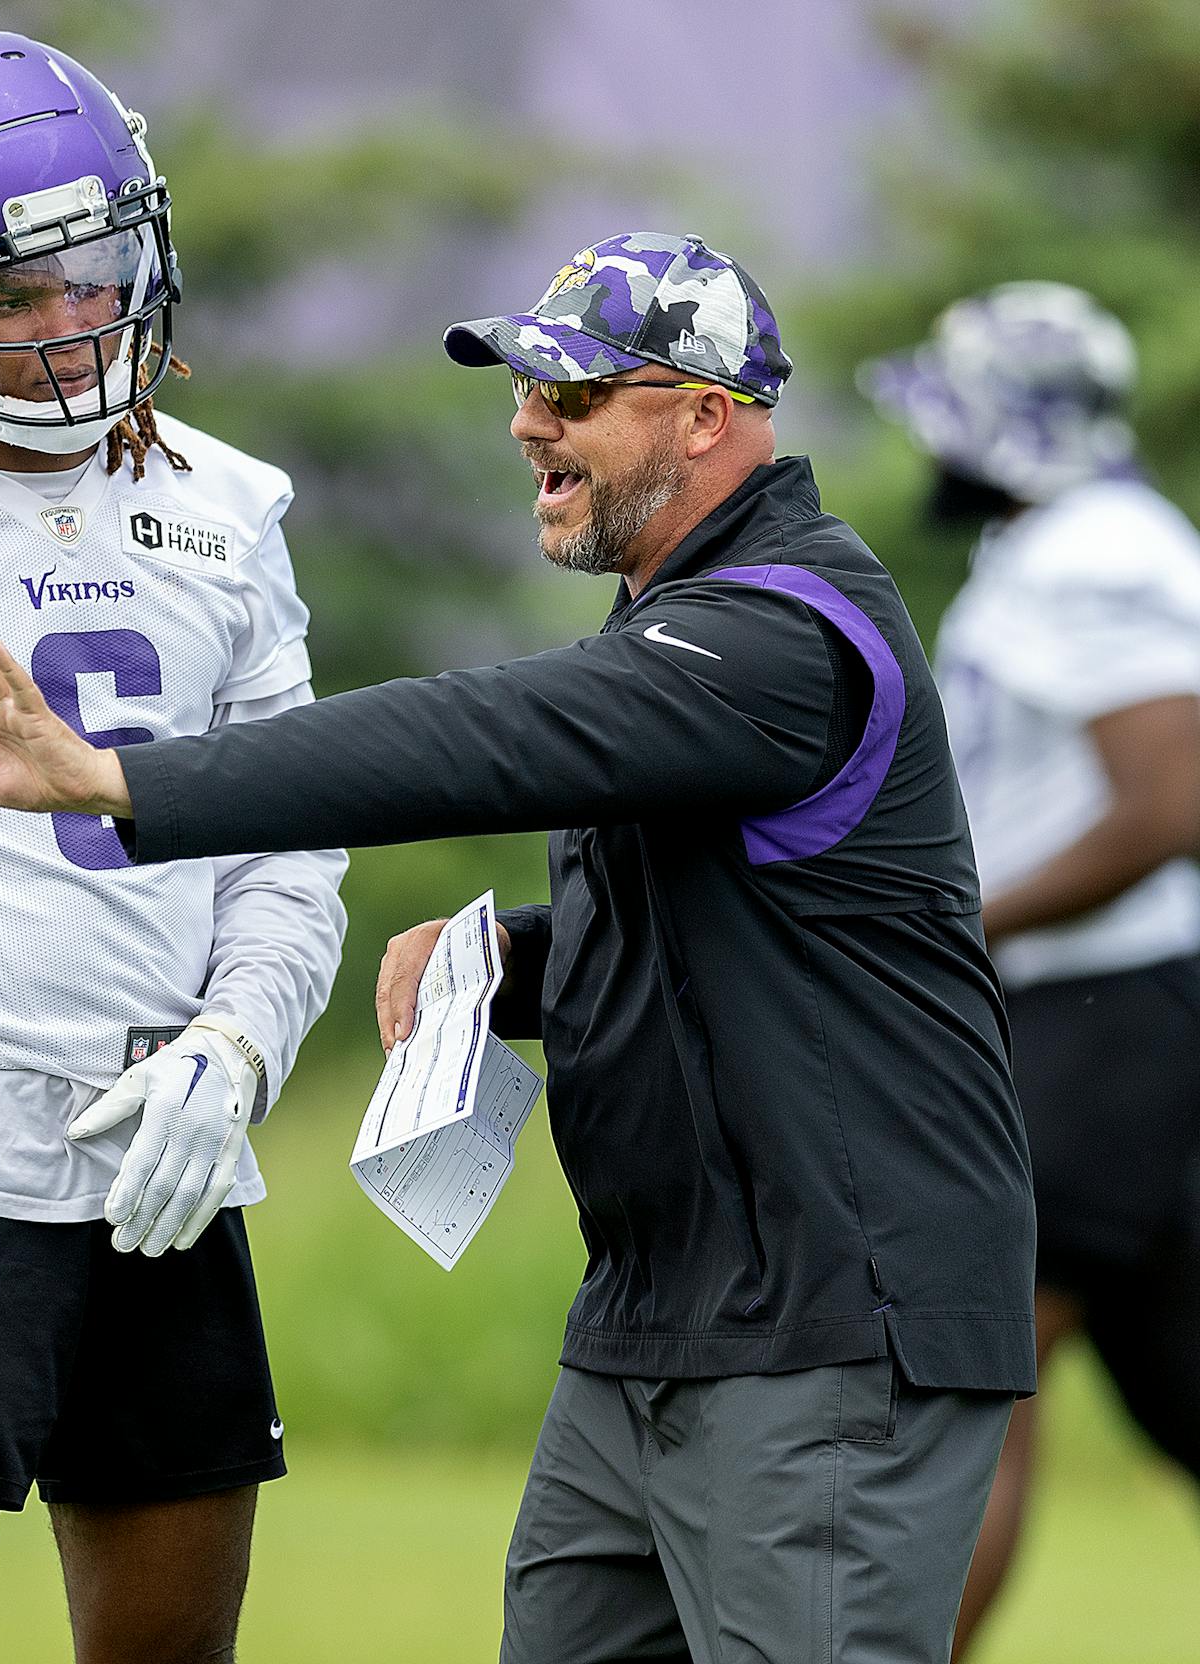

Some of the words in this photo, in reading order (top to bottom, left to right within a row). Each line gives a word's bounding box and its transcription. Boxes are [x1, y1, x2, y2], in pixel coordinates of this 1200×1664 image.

[59, 523, 77, 536] NFL
[168, 522, 226, 544] TRAINING
[168, 532, 227, 562] HAUS
[31, 628, 162, 871] 6
[236, 1034, 254, 1054] ALL
